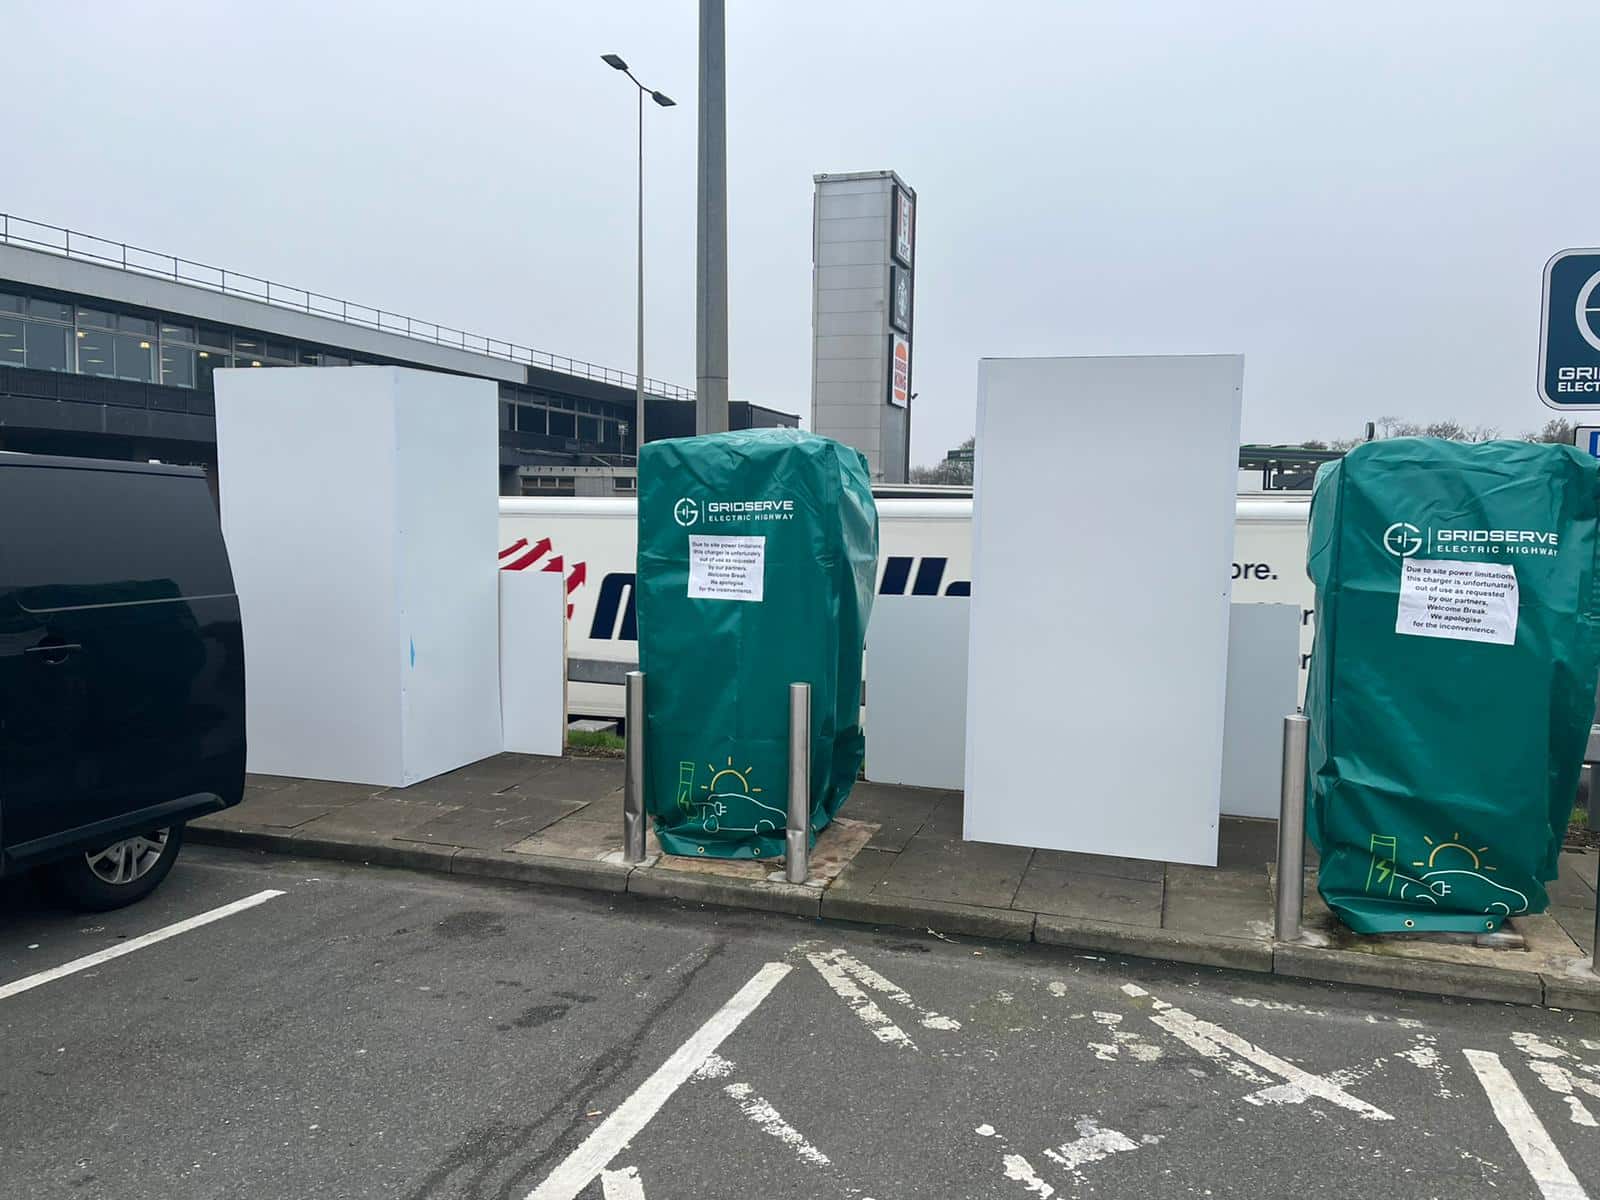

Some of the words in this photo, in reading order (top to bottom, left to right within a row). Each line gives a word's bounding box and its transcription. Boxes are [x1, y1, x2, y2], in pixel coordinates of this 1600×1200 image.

[1558, 367, 1600, 380] GRI
[708, 500, 794, 512] GRIDSERVE
[708, 514, 751, 522] ELECTRIC
[754, 513, 794, 521] HIGHWAY
[1437, 529, 1558, 545] GRIDSERVE
[1437, 545, 1500, 554] ELECTRIC
[1474, 571, 1514, 580] limitations
[1422, 577, 1452, 585] charger
[1462, 579, 1514, 591] unfortunately
[1465, 589, 1505, 598] requested
[1454, 597, 1488, 606] partners,
[1427, 604, 1461, 612] Welcome
[1444, 615, 1482, 624] apologise
